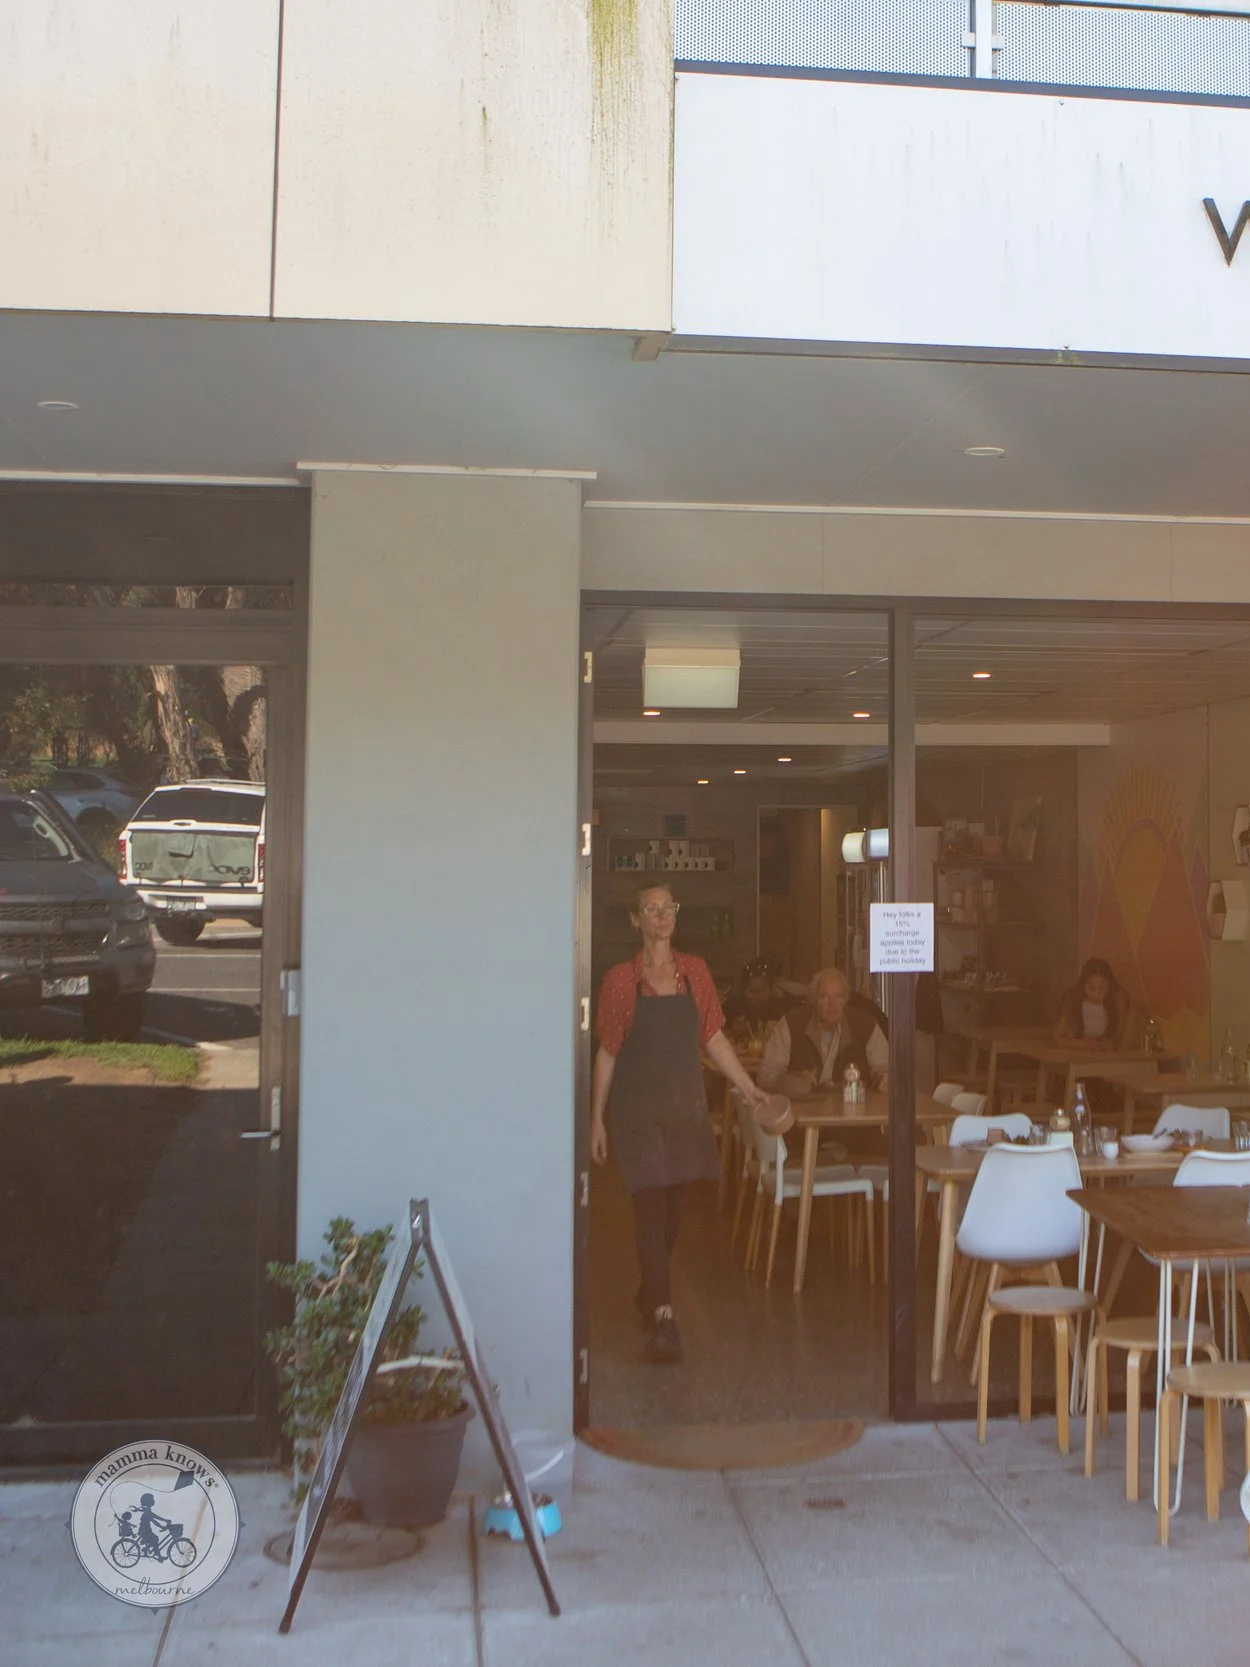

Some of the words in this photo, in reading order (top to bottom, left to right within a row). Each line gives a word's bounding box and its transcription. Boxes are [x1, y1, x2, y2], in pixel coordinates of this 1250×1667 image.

[883, 911, 897, 919] Hey
[880, 939, 904, 947] applies
[906, 939, 926, 947] today
[879, 957, 900, 966] public
[901, 957, 927, 965] holiday
